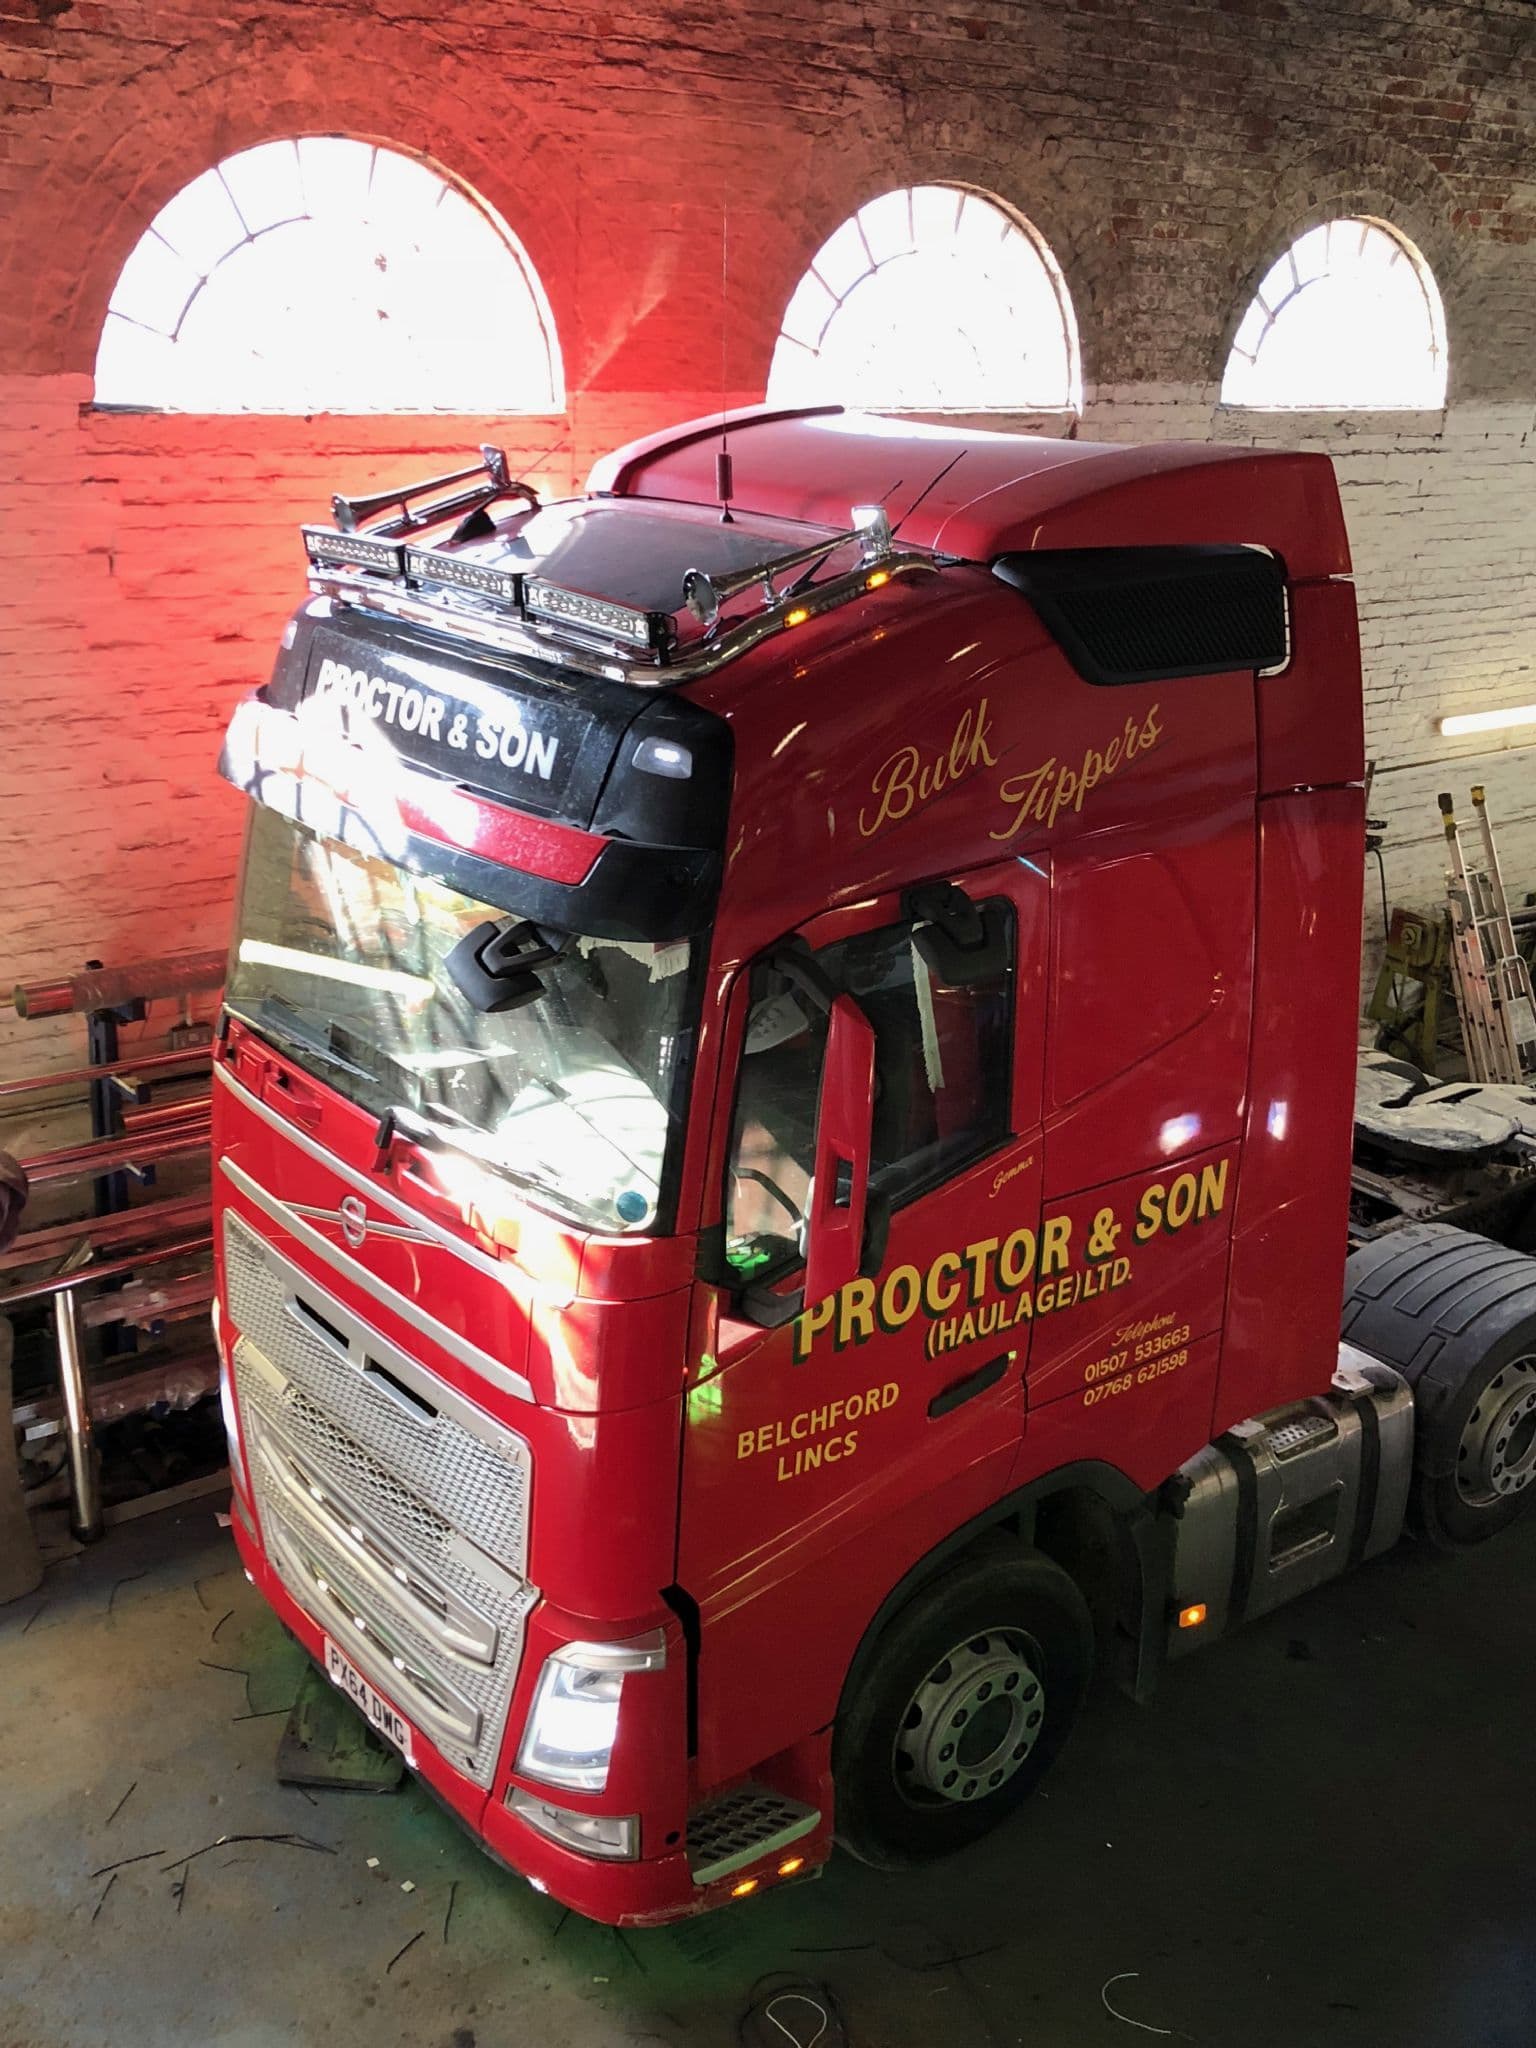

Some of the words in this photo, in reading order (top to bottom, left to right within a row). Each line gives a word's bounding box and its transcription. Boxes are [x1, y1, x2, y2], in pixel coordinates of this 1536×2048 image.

[315, 658, 446, 742] PROCTOR
[447, 713, 469, 751] &
[475, 711, 559, 780] SON
[858, 698, 998, 837] Bulk
[988, 703, 1163, 841] Tippers
[793, 1214, 1073, 1365] PROCTOR
[1085, 1206, 1122, 1259] &
[1132, 1158, 1230, 1245] SON
[1083, 1373, 1133, 1407] 07768
[1137, 1349, 1188, 1385] 621598
[1084, 1350, 1129, 1382] 01507
[1134, 1324, 1191, 1362] 533663
[736, 1382, 900, 1460] BELCHFORD
[776, 1431, 858, 1482] LINCS
